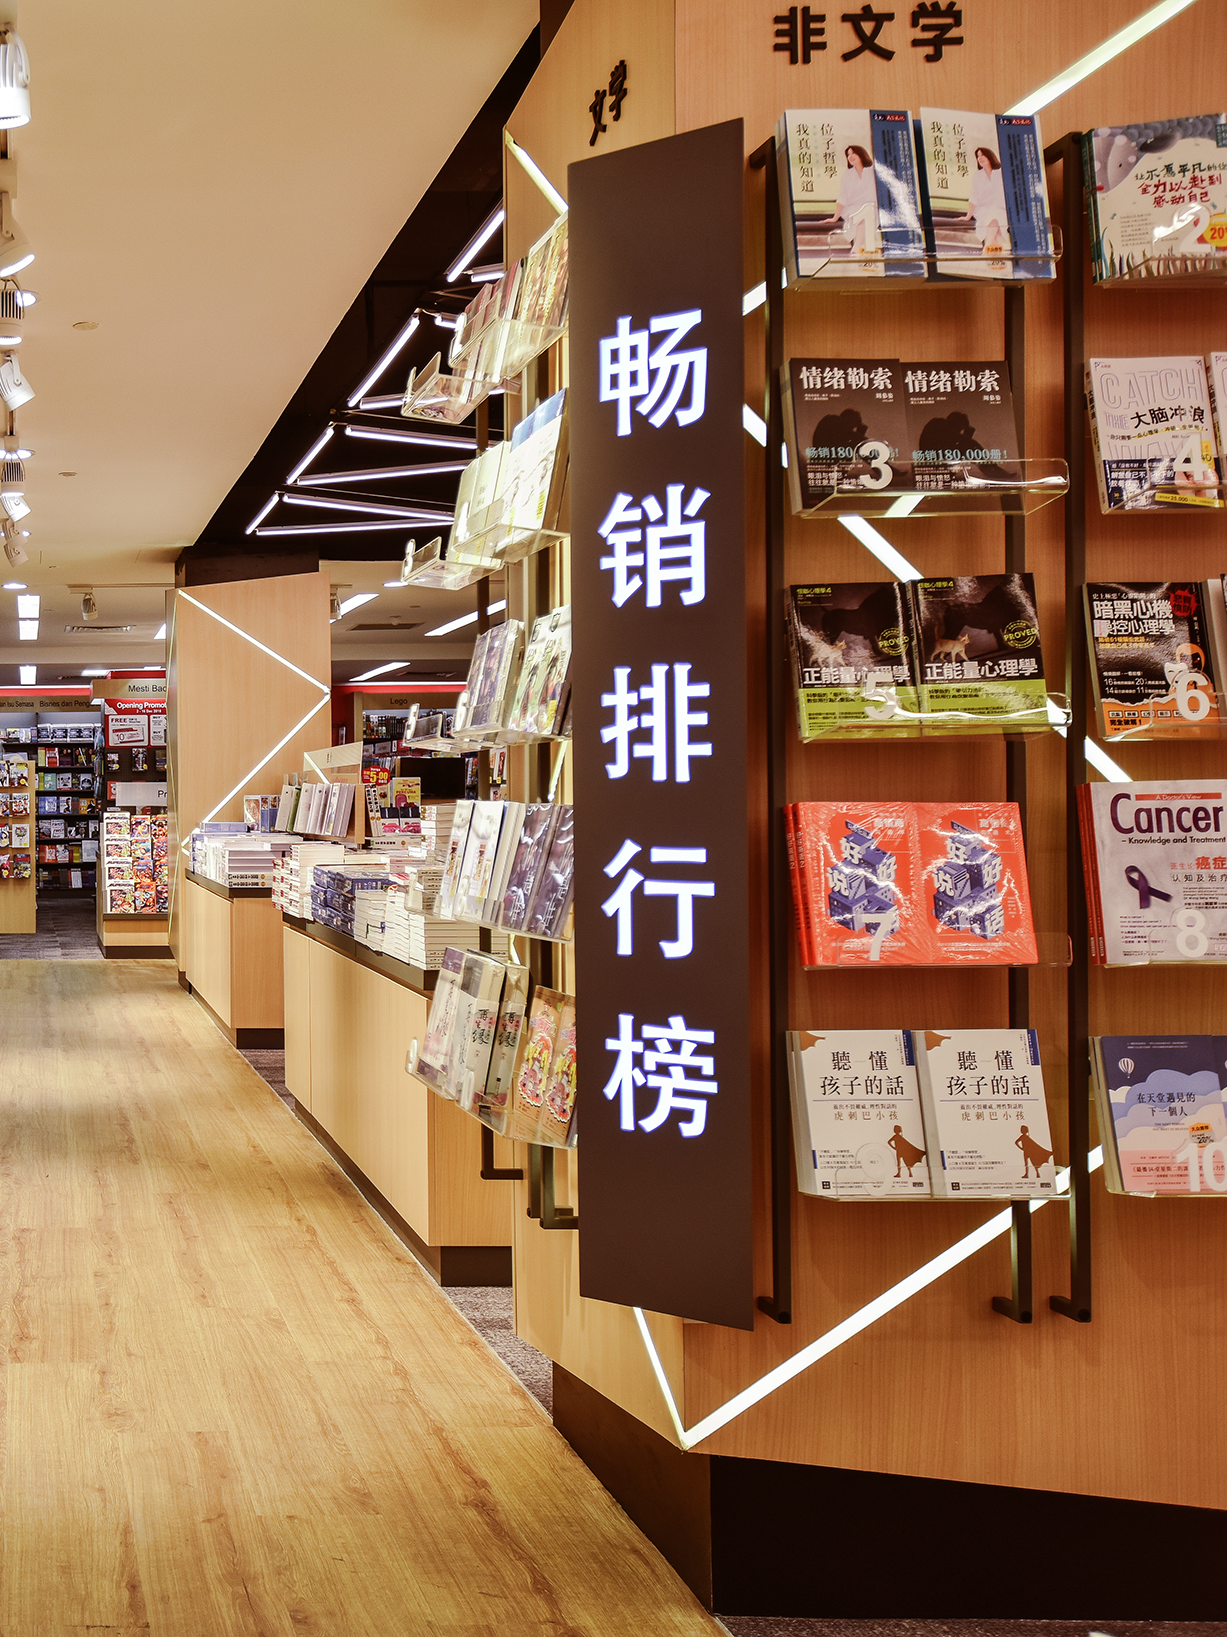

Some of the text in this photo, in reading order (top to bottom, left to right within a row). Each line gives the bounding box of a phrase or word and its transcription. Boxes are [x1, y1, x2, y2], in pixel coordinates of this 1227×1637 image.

[773, 1, 964, 65] 非文学
[588, 59, 629, 147] 文学
[795, 122, 815, 194] 我真的知道
[930, 120, 950, 191] 我真的知道
[1178, 203, 1212, 253] 2
[799, 366, 893, 391] 情绪勒索
[905, 369, 1001, 394] 情绪勒索
[1130, 404, 1205, 429] 大脑冲浪
[858, 440, 894, 490] 3
[1173, 431, 1211, 481] 4
[1093, 599, 1174, 620] 暗黑心機
[1003, 627, 1038, 642] PROVED
[924, 657, 1039, 681] 正能量心理學
[128, 685, 150, 693] Mesti
[863, 671, 897, 720] 5
[1175, 672, 1211, 722] 6
[39, 700, 73, 708] Bisnes dan
[116, 702, 143, 710] Opening
[390, 698, 408, 706] Lego
[598, 308, 720, 1138] 畅销排行榜
[1110, 792, 1224, 835] Cancer
[1128, 837, 1171, 846] Knowledge
[1190, 836, 1226, 844] Treatment
[860, 913, 892, 961] 7
[1176, 908, 1209, 958] 8
[820, 1075, 905, 1097] 孩子的話
[946, 1075, 1030, 1097] 孩子的話
[1136, 1092, 1196, 1104] 在天堂遇見的
[834, 1111, 899, 1121] 虎刺巴小孩
[961, 1110, 1026, 1121] 虎刺巴小孩
[1148, 1106, 1188, 1117] 下一個人
[1176, 1142, 1227, 1193] 10
